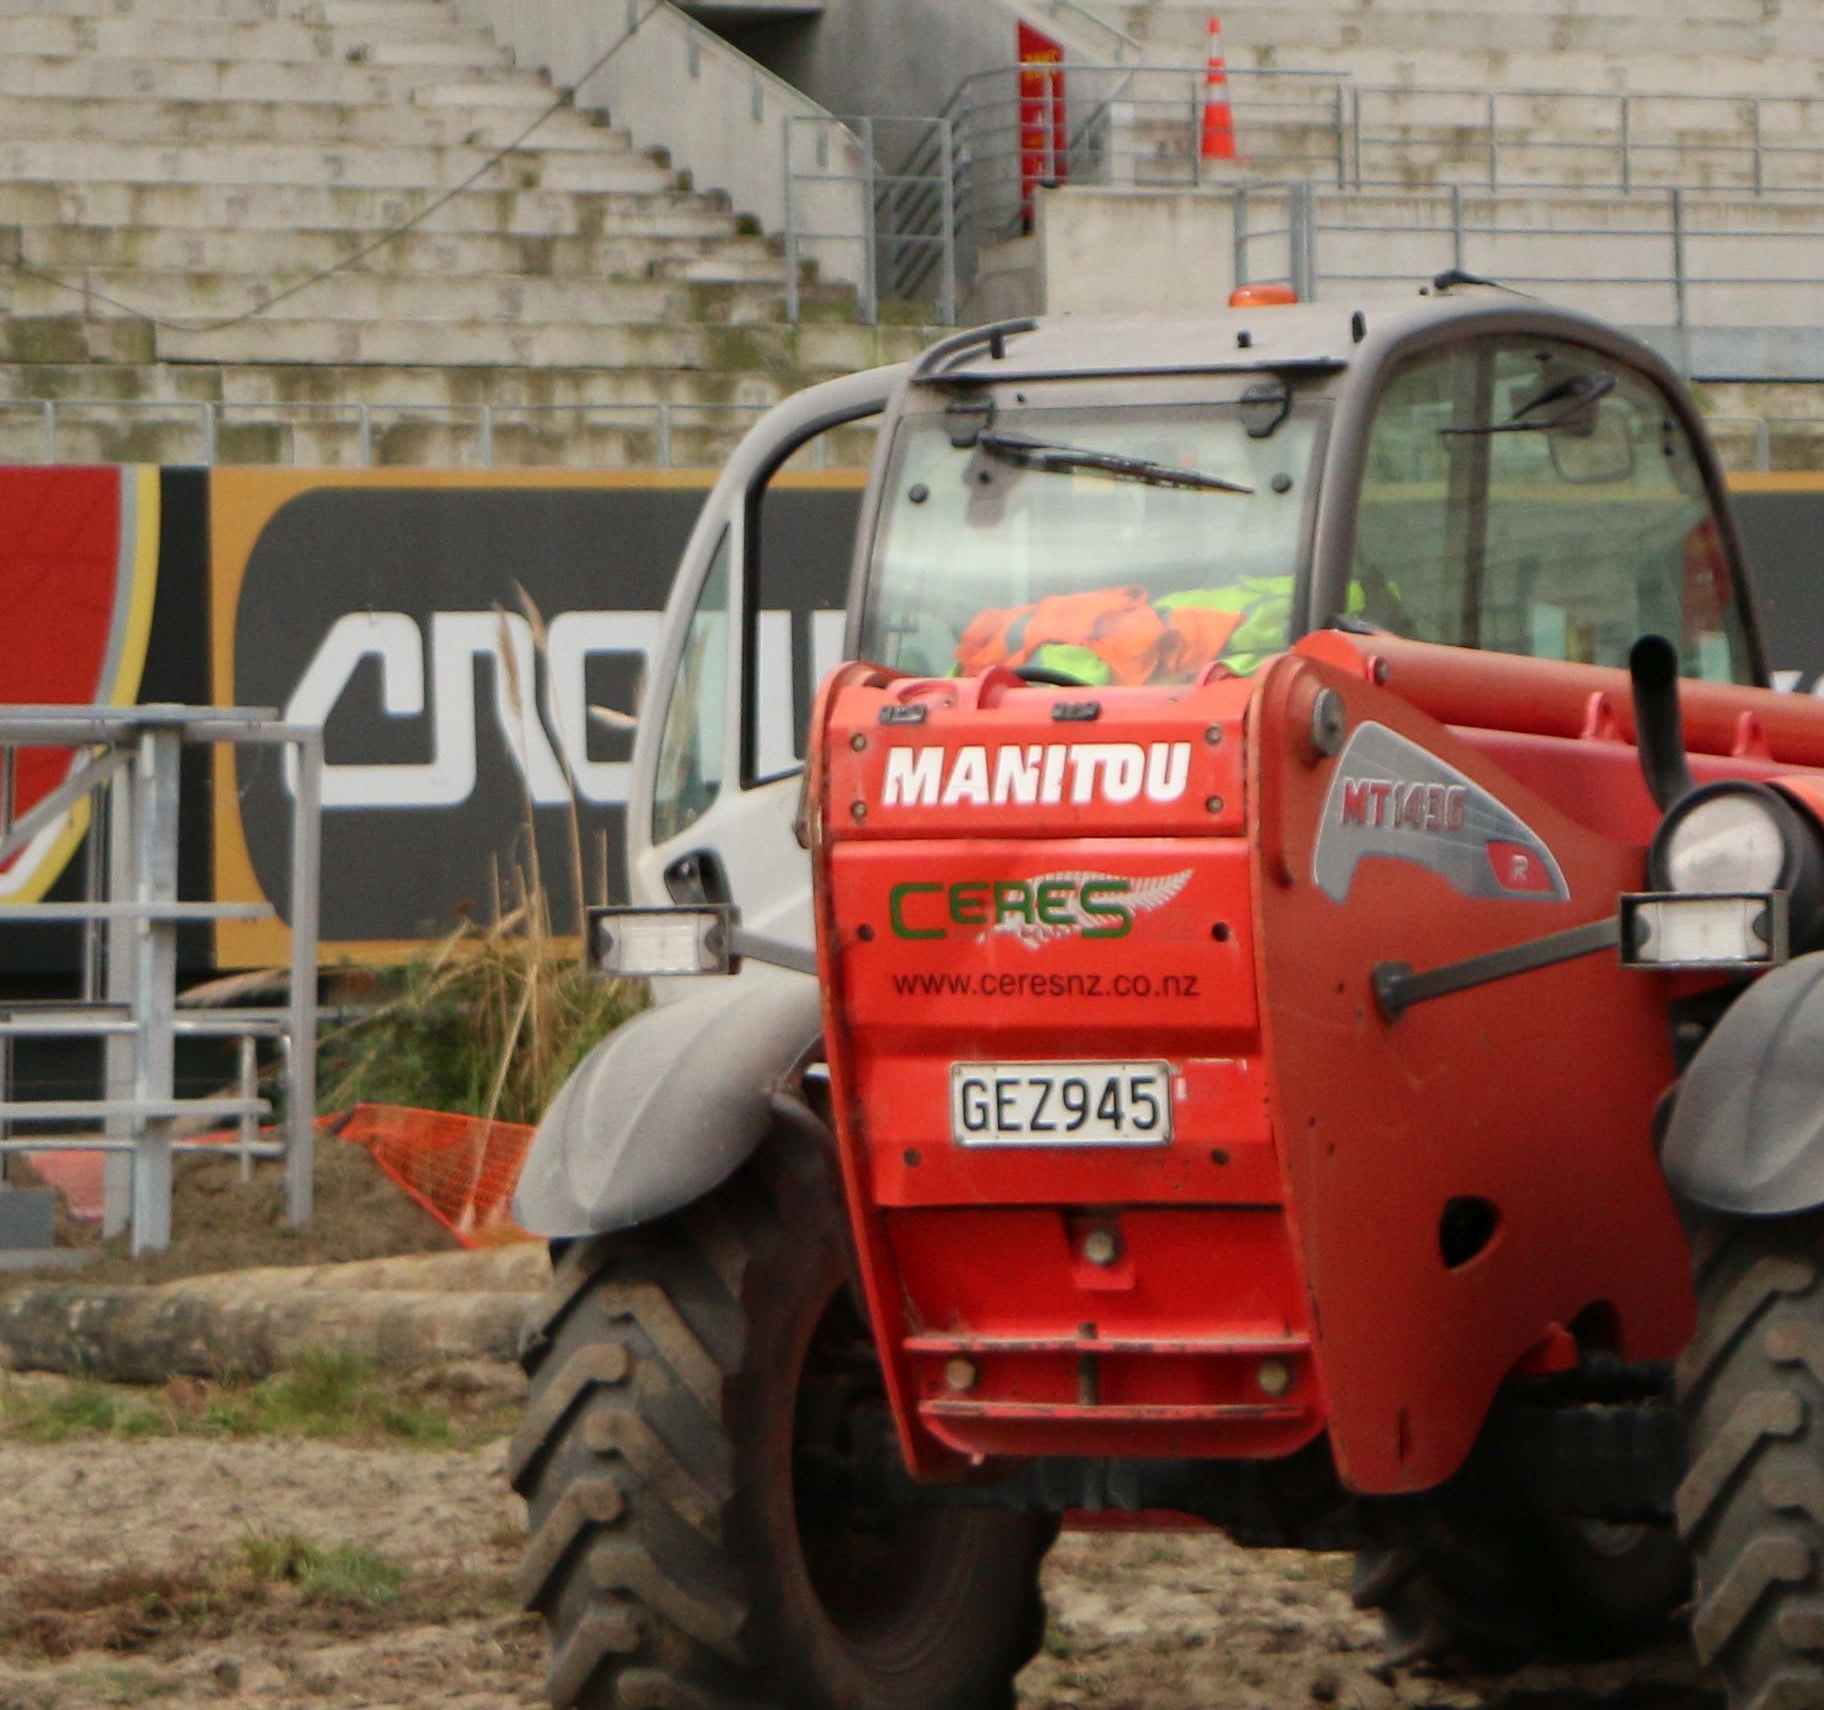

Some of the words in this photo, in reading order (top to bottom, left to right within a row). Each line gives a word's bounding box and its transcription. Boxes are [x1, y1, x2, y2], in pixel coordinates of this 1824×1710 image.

[882, 742, 1192, 807] MANITOU
[888, 880, 1132, 941] CERES
[892, 972, 1200, 997] www.ceresnz.co.nz
[961, 1076, 1161, 1134] GEZ945
